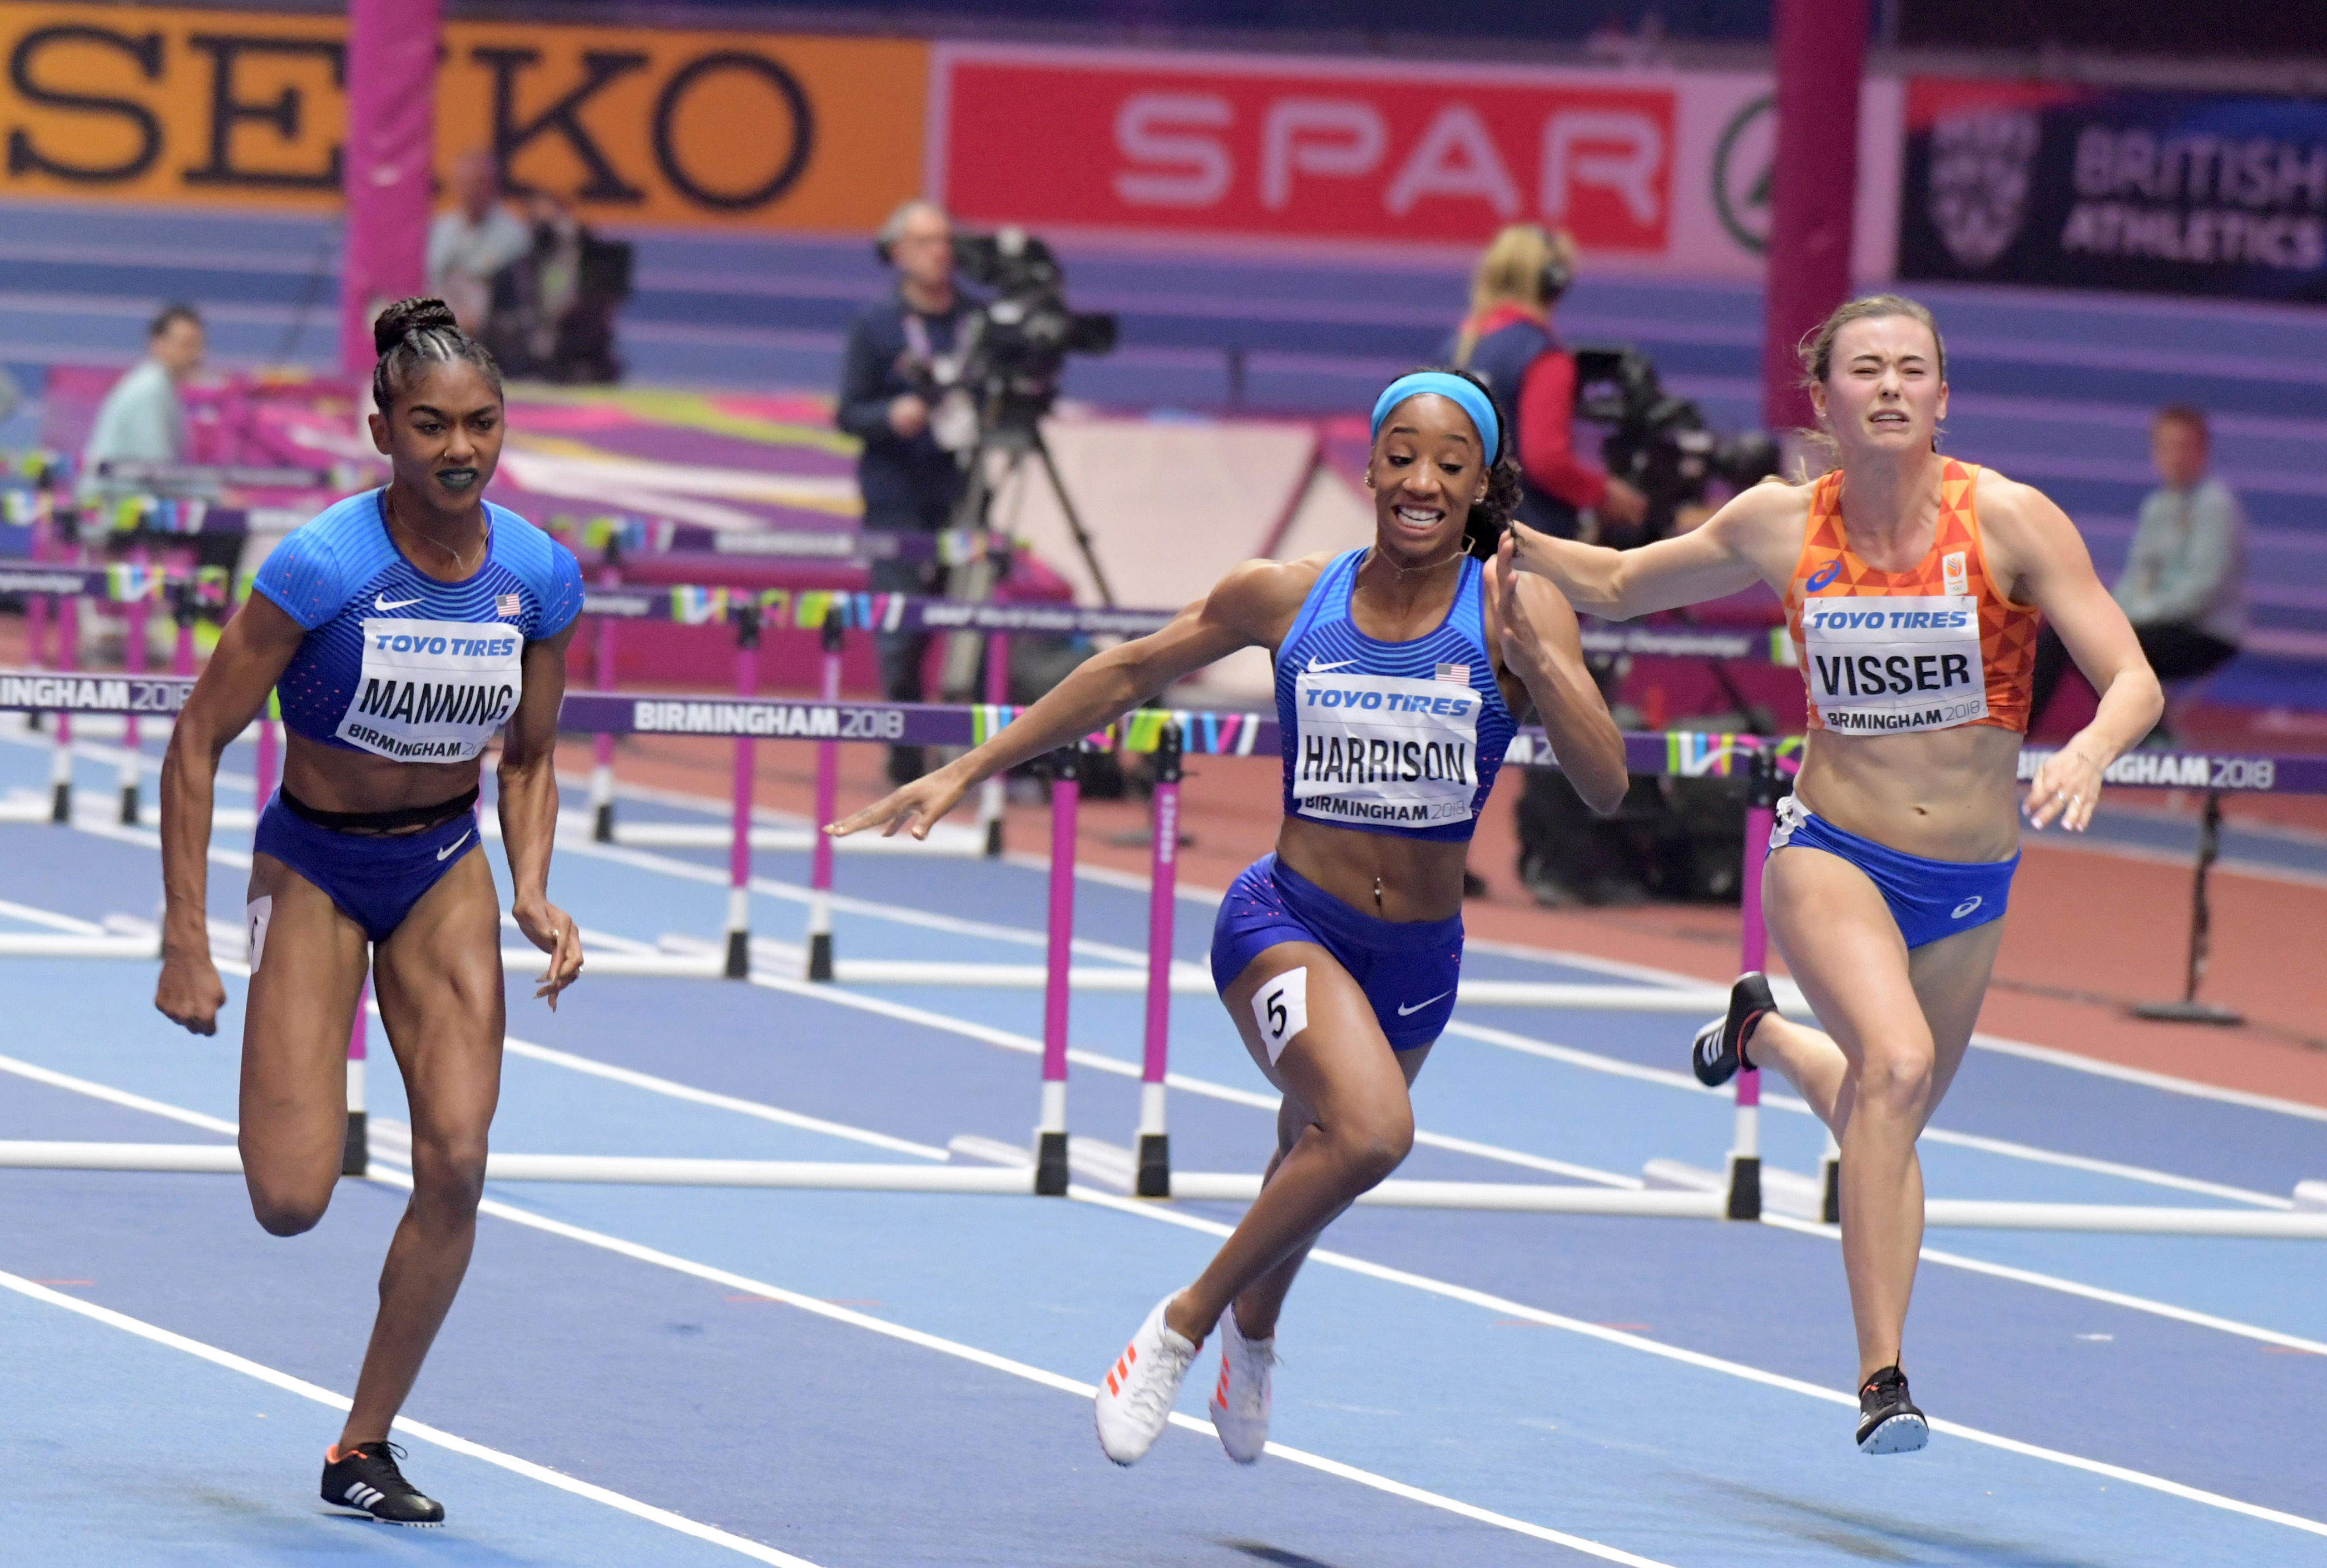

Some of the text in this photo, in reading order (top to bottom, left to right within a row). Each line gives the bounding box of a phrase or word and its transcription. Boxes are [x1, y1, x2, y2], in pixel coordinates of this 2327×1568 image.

[9, 23, 814, 212] SEKO
[1113, 92, 1664, 223] SPAR
[2075, 125, 2327, 209] BRITISH
[2060, 201, 2325, 271] ATHLETICS
[1813, 612, 1967, 629] TOYO TIRES
[376, 635, 515, 656] TOYO TIRES
[1815, 654, 1970, 696] VISSER
[359, 678, 512, 726] MANNING
[634, 701, 905, 740] BIRMINGHAM 2018
[1306, 689, 1472, 716] TOYO TIRES
[1828, 701, 1980, 729] BRMINGHAM 2018
[348, 723, 462, 757] BIRMINGHAM
[1304, 735, 1467, 785] HARRISON
[2211, 758, 2275, 788] 2018
[1305, 796, 1465, 820] BIRMINGHAM 2018
[1268, 989, 1286, 1039] 5
